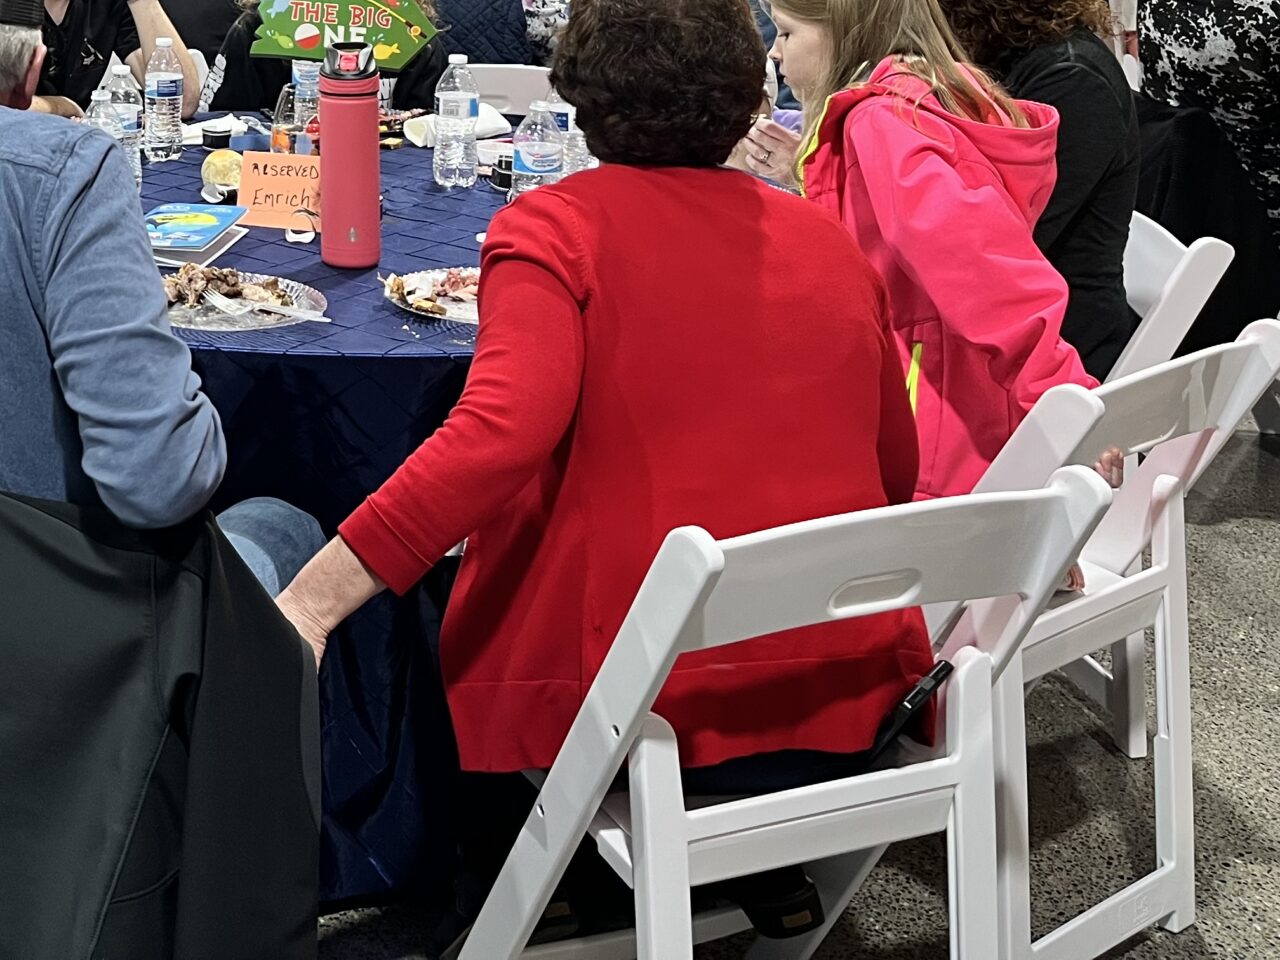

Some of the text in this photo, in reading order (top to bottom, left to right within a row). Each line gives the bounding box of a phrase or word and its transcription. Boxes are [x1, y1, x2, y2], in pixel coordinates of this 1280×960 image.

[289, 0, 393, 29] THE BIG
[252, 187, 311, 208] Emrich
